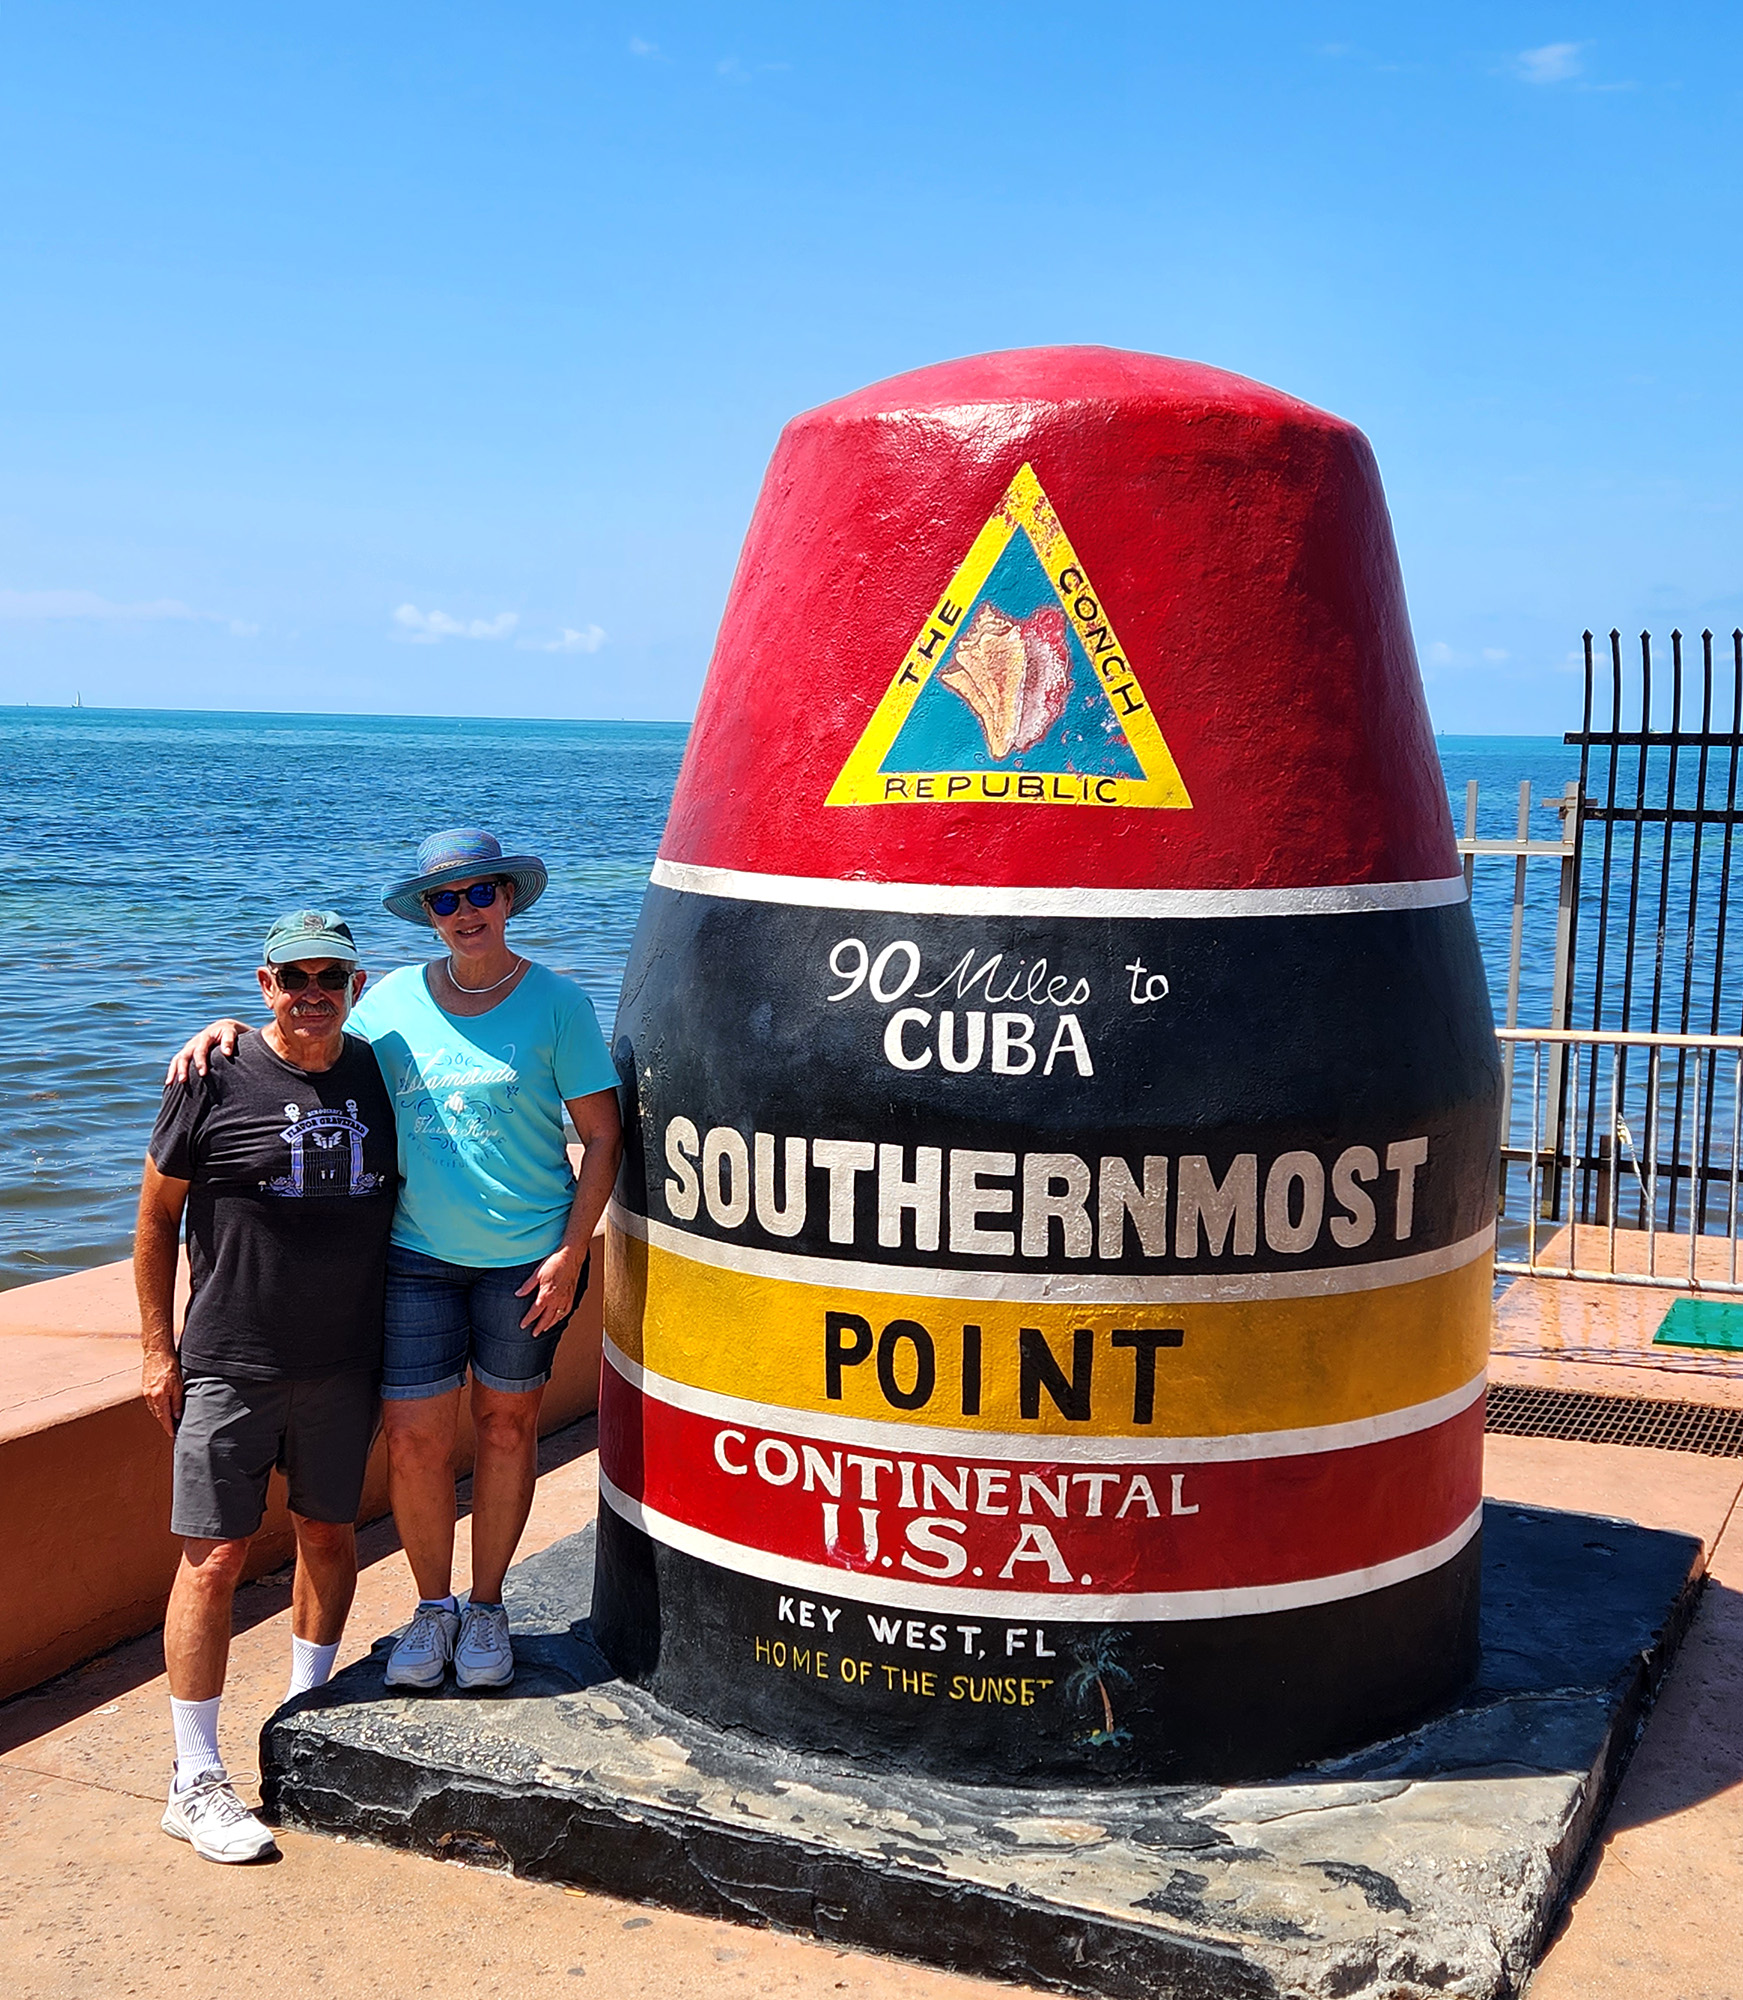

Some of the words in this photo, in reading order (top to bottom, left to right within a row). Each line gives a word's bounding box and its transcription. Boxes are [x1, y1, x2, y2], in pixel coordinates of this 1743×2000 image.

[898, 599, 963, 686] THE
[1059, 568, 1144, 716] CONCH
[884, 775, 1117, 803] REPUBLIC
[827, 938, 921, 1003] 90
[914, 948, 1091, 1006] Miles
[1125, 957, 1169, 1005] to
[883, 1007, 1094, 1077] CUBA
[286, 1119, 318, 1138] FLAVOR
[664, 1116, 1428, 1259] SOUTHERNMOST
[824, 1310, 1184, 1425] POINT
[713, 1429, 1200, 1519] CONTINENTAL
[822, 1503, 1093, 1586] U.S.A.
[778, 1595, 842, 1633] KEY
[867, 1613, 987, 1660] WEST,
[1005, 1628, 1057, 1658] FL
[755, 1636, 829, 1680] HOME
[839, 1657, 873, 1687] OF
[880, 1664, 938, 1698] THE
[948, 1675, 1055, 1707] SUNSET
